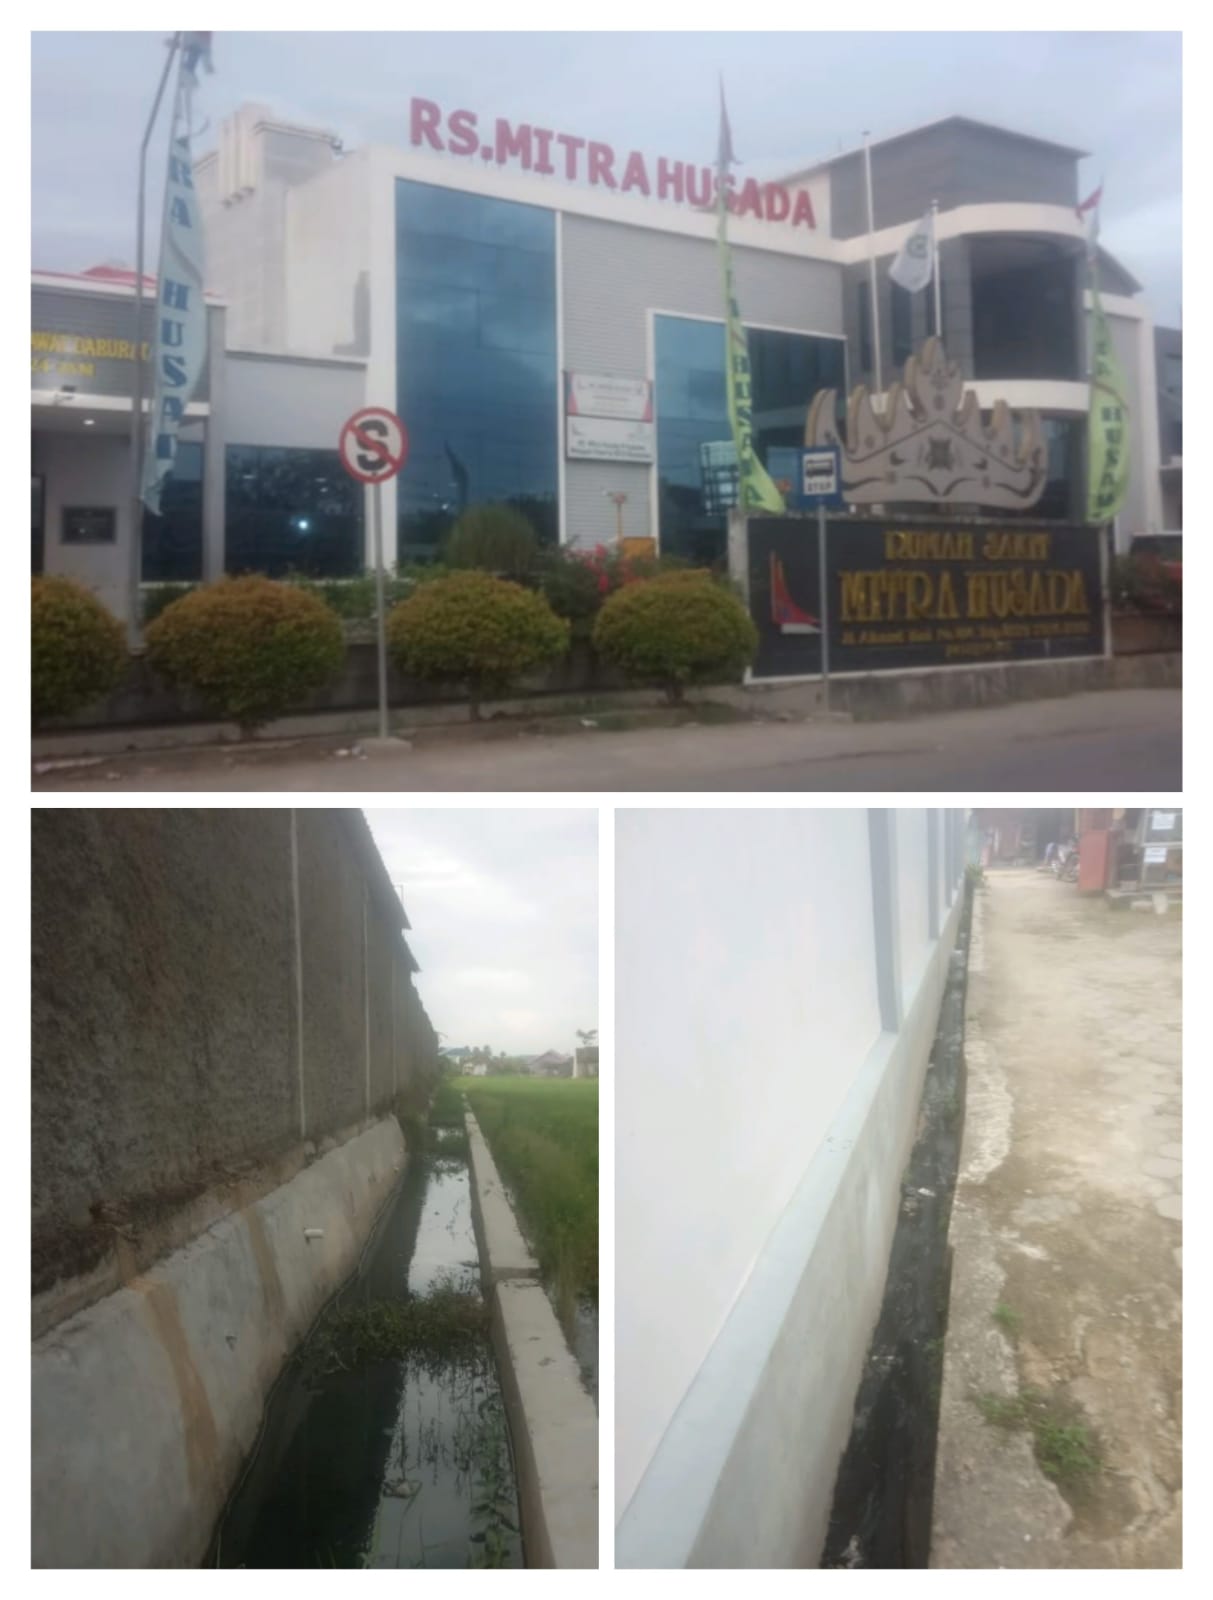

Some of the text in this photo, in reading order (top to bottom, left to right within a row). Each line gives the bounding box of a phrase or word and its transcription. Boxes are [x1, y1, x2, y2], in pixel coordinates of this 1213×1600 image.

[355, 419, 389, 471] S
[883, 530, 1049, 560] RUMAH SAKIT
[838, 568, 1090, 622] MITRA HUSADA
